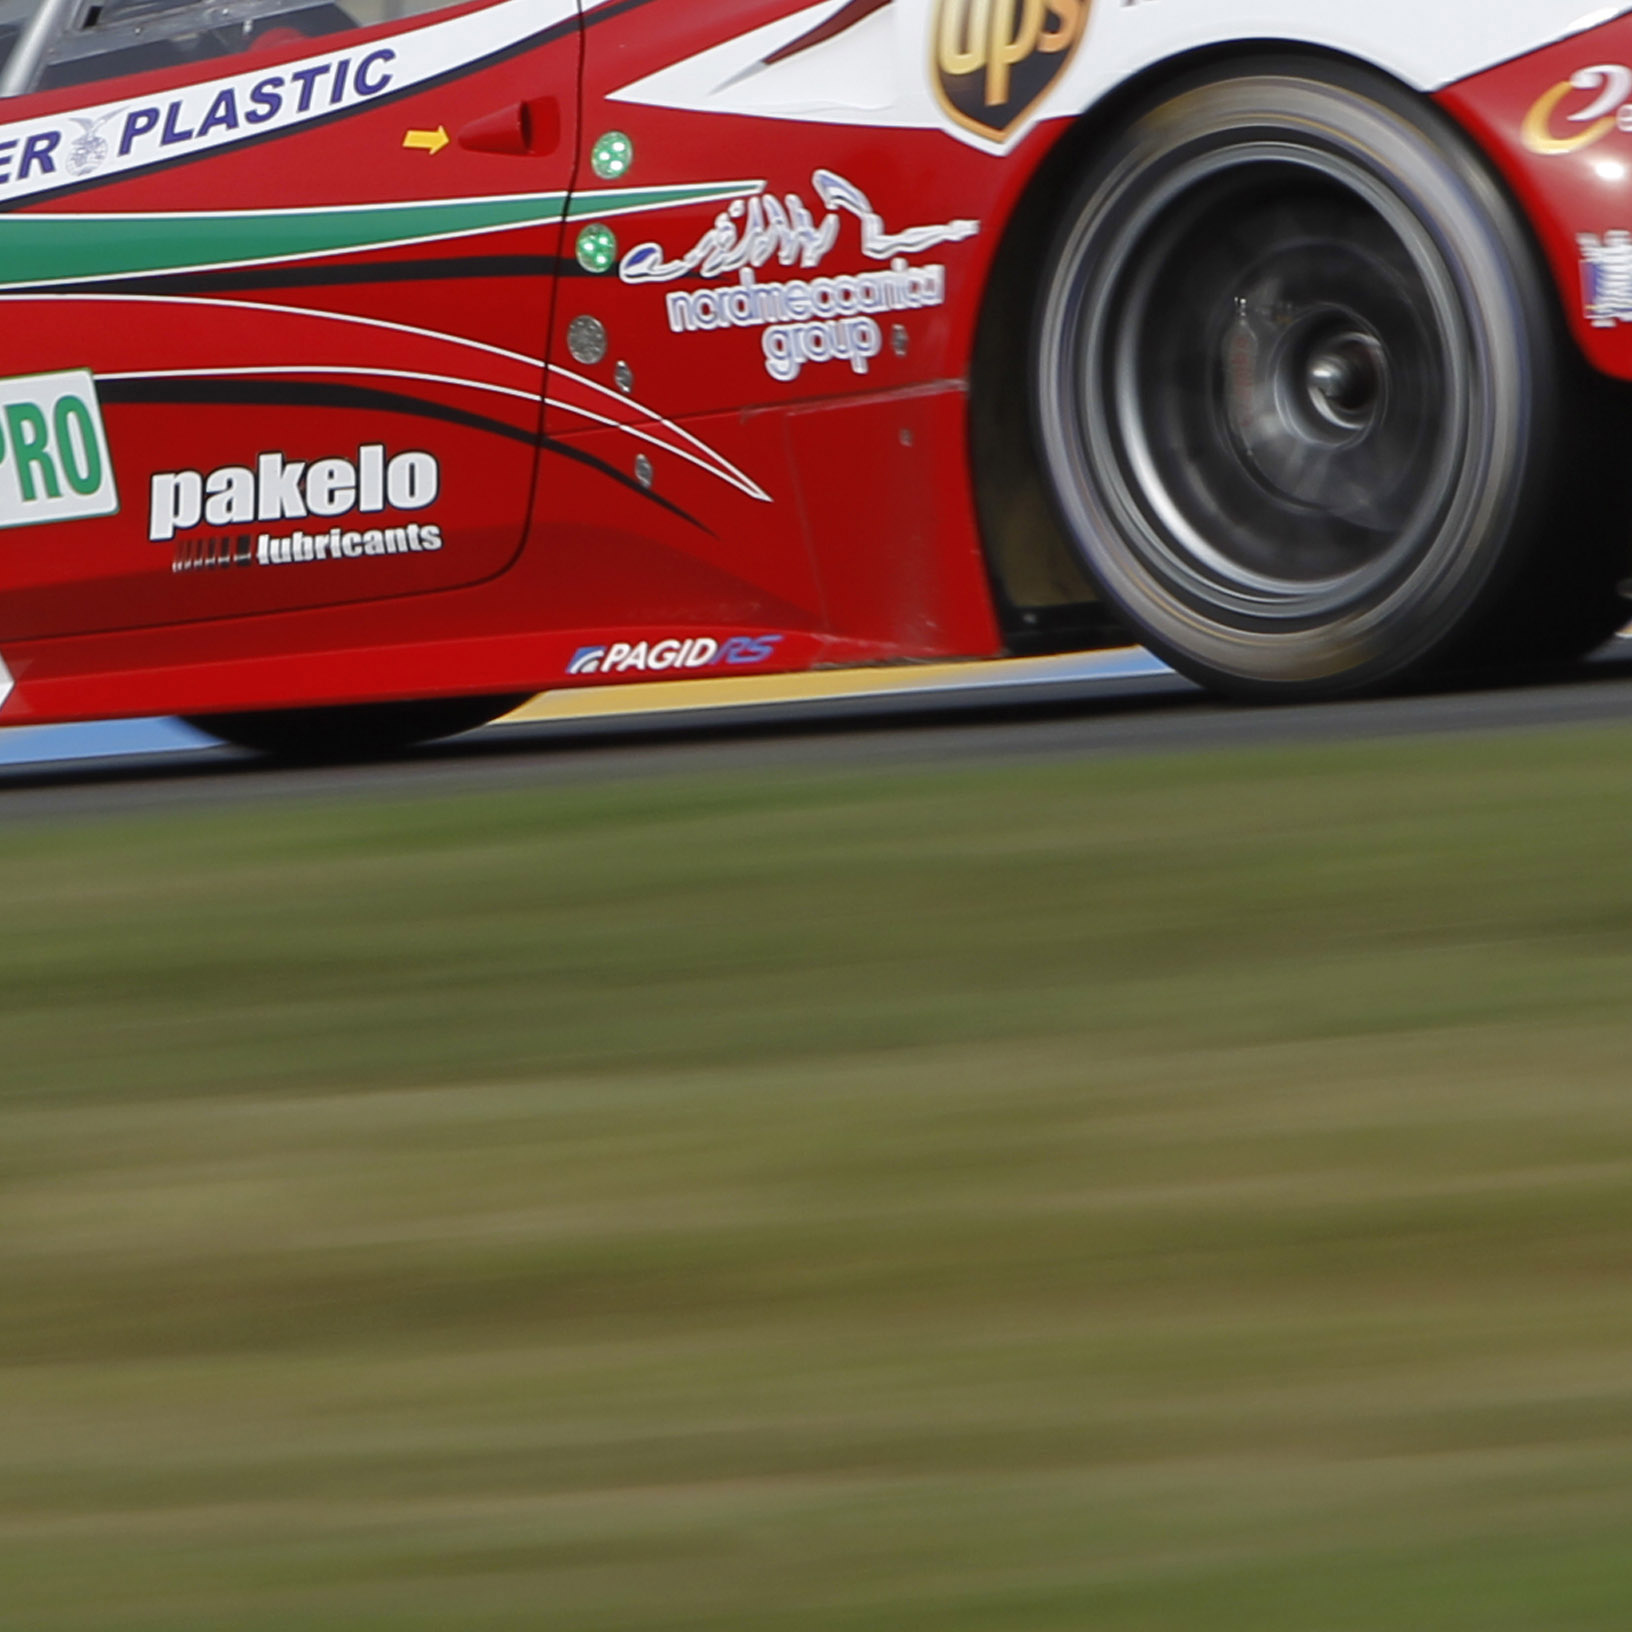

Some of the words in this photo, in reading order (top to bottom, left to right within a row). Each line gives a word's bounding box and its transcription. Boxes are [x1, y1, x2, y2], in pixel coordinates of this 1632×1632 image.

[118, 48, 397, 156] PLASTIC
[762, 316, 882, 381] group
[149, 443, 439, 541] pakelo
[257, 523, 443, 565] lubricants
[600, 637, 718, 672] PAGID
